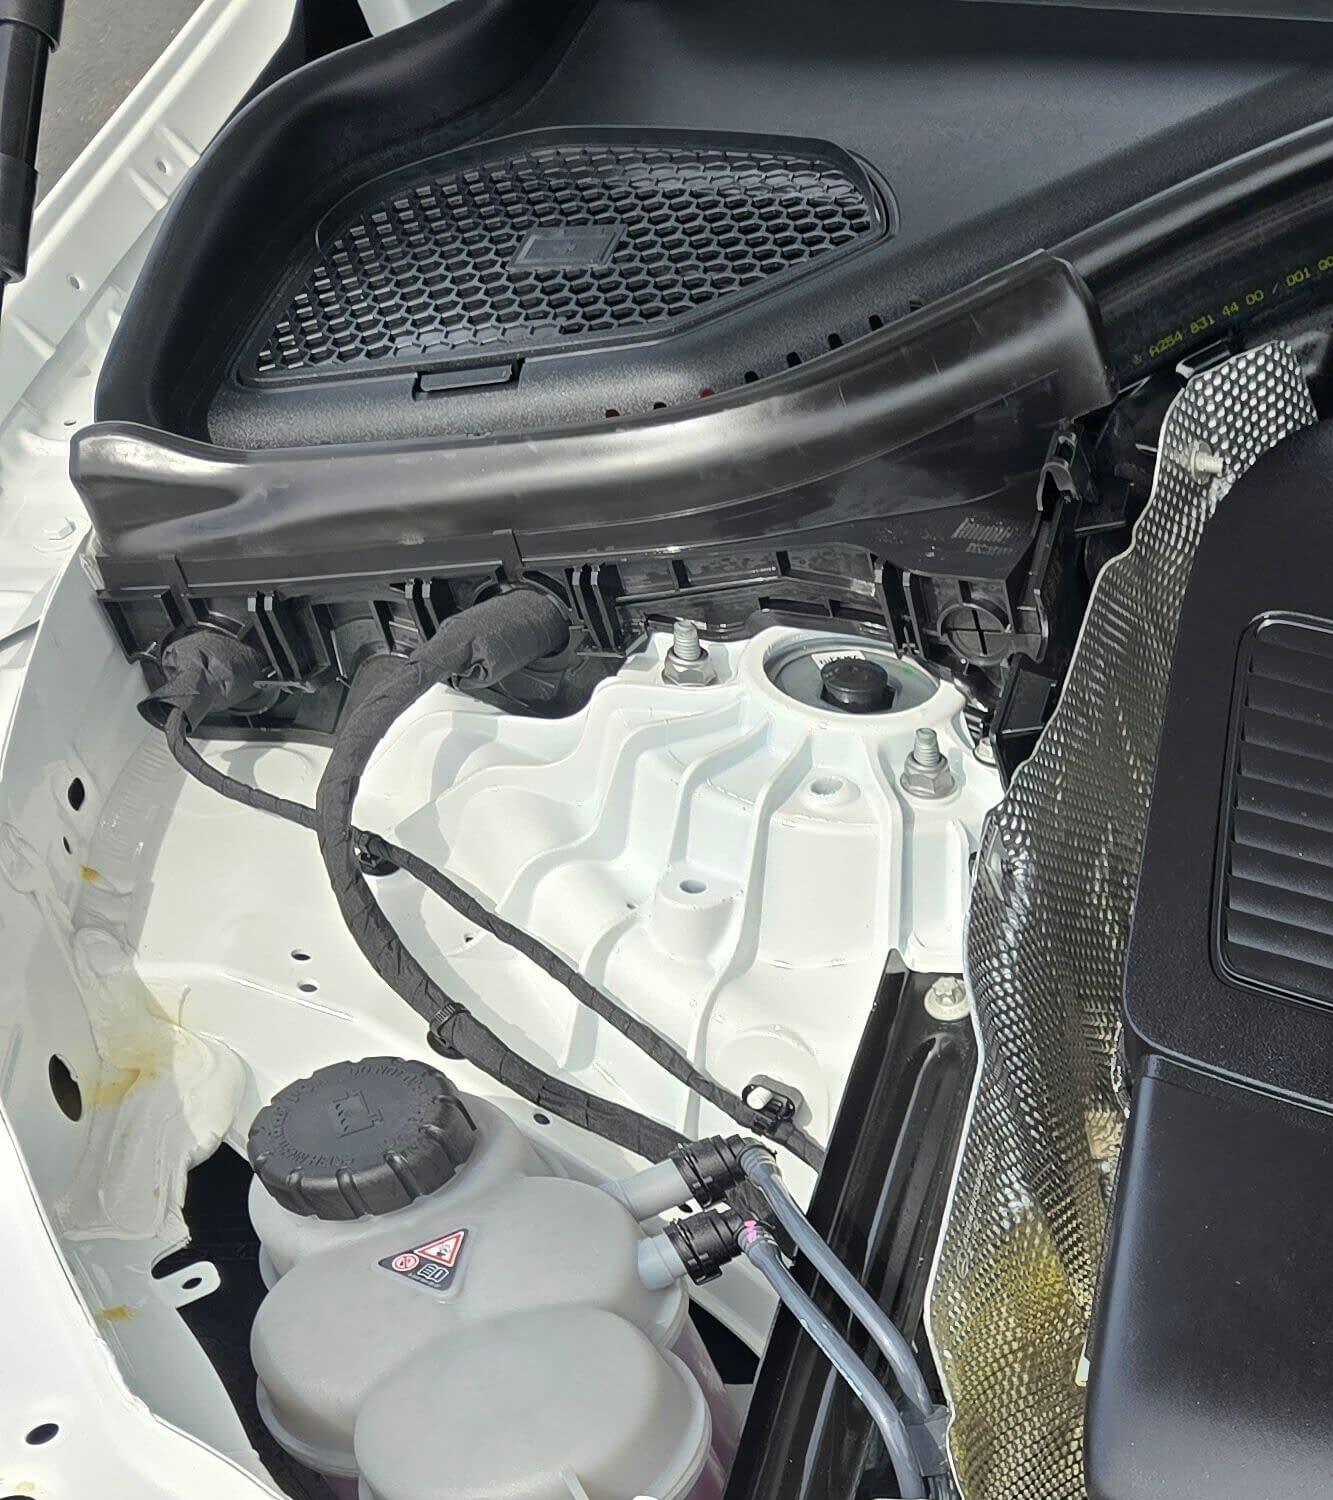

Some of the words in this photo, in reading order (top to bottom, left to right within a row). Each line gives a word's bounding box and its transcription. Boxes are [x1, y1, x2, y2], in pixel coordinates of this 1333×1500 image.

[1222, 302, 1239, 317] 44
[1246, 290, 1264, 305] 00
[1286, 268, 1311, 286] 001
